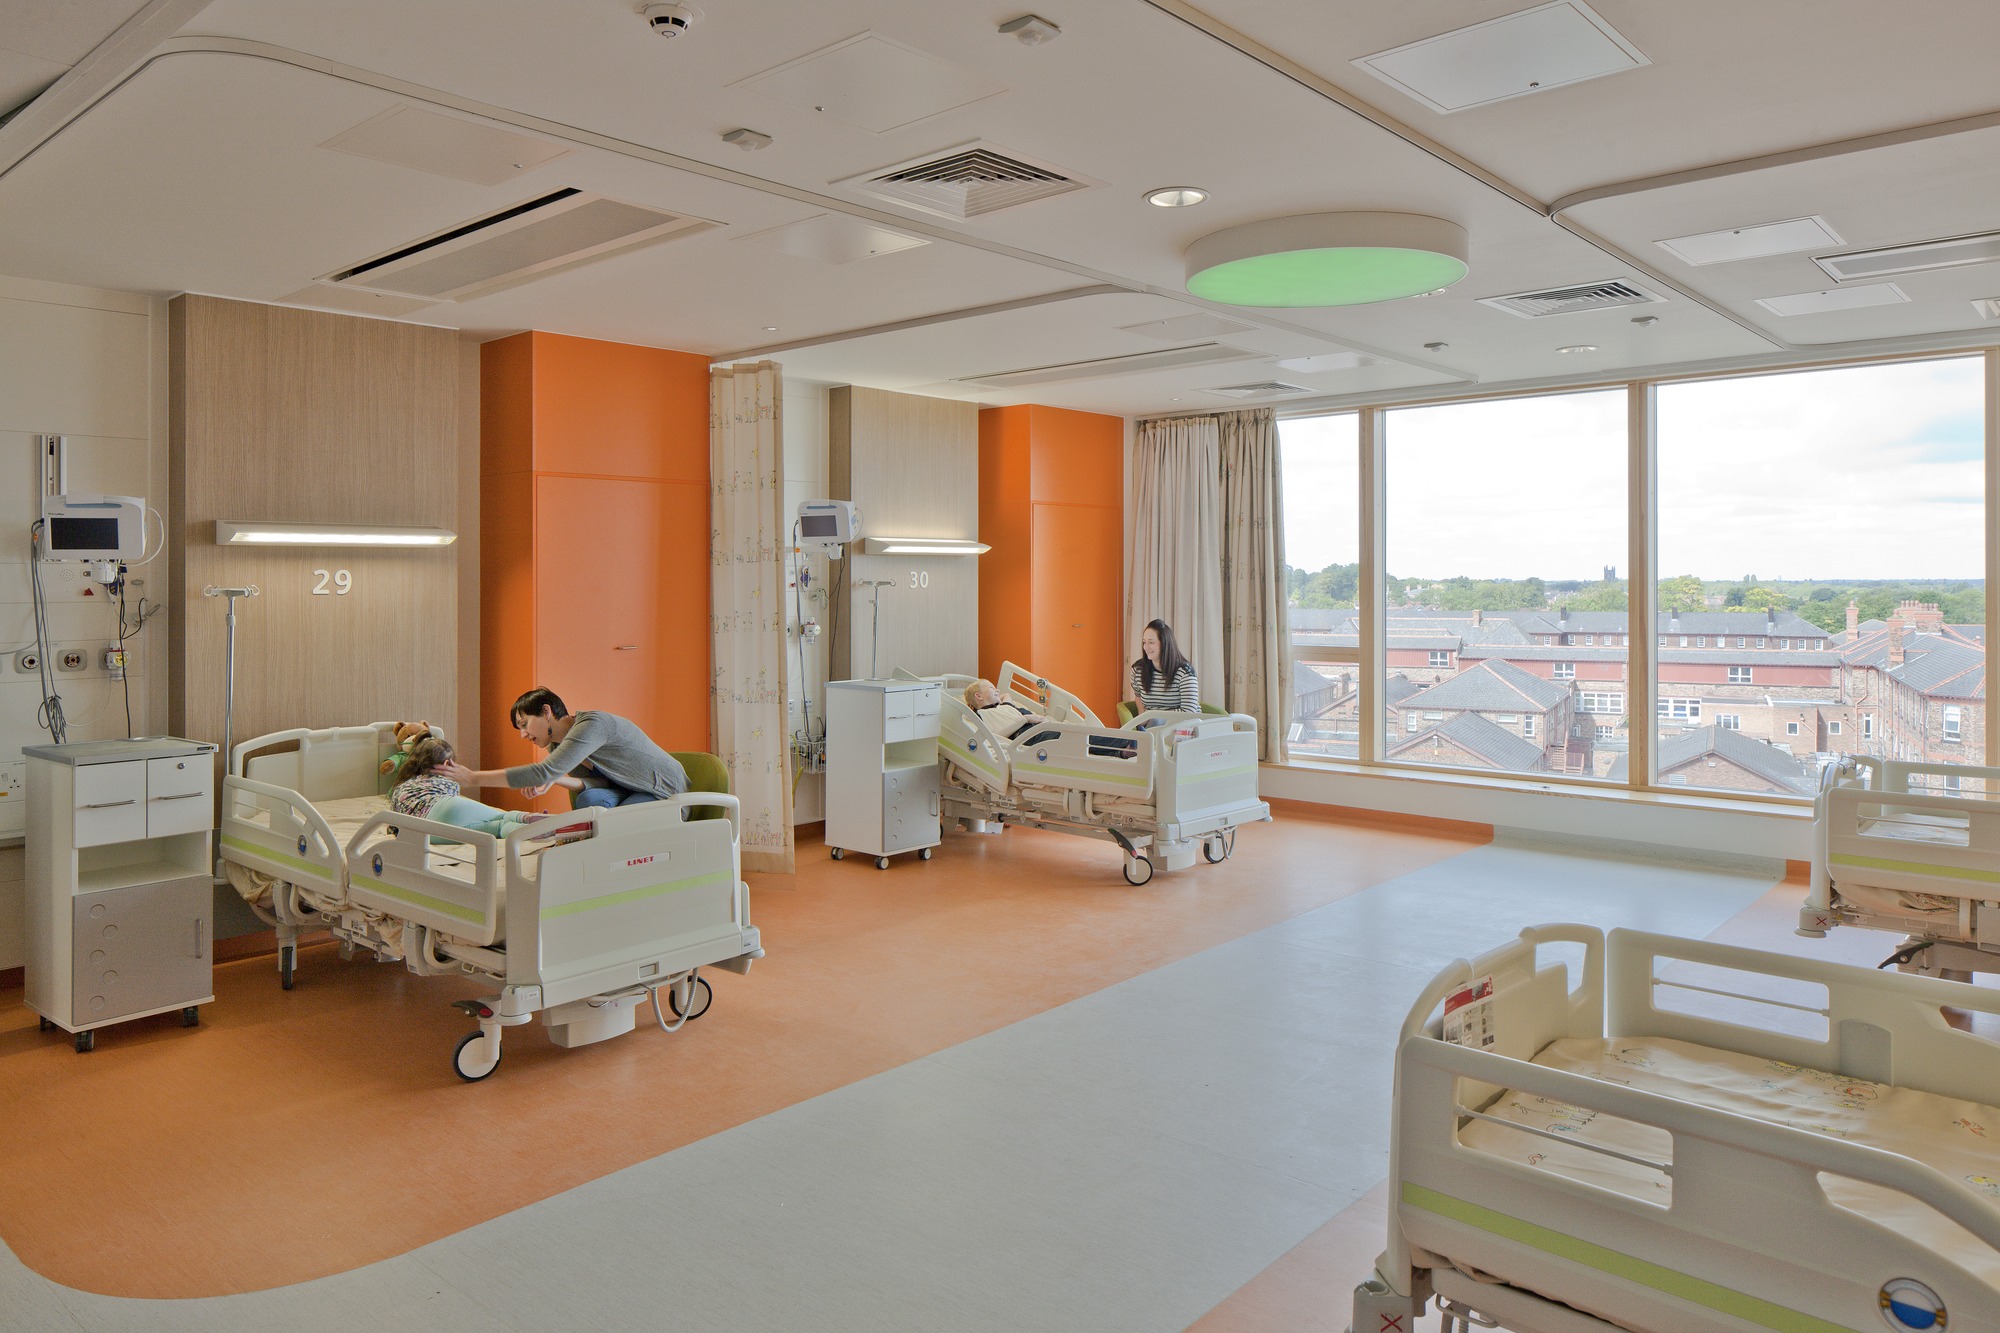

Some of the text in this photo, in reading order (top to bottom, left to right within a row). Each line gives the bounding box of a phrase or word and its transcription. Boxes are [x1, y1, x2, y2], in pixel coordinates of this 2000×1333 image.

[312, 569, 352, 595] 29
[909, 571, 929, 589] 30
[627, 855, 654, 866] LINET
